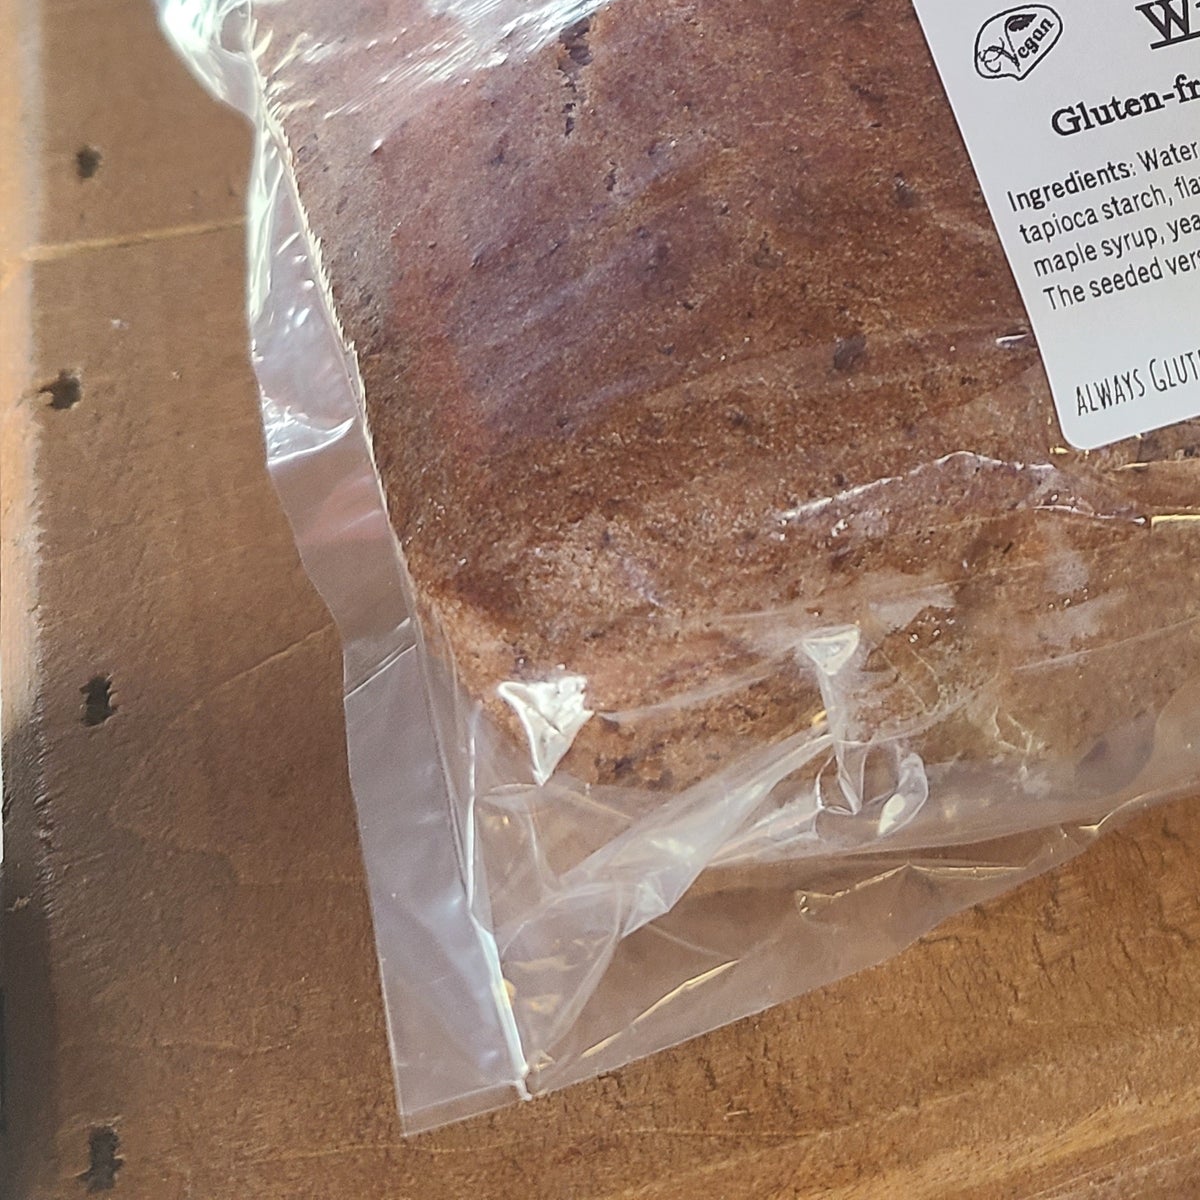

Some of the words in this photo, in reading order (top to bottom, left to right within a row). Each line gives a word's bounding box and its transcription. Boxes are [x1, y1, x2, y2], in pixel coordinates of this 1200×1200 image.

[977, 14, 1054, 72] Vegan
[1007, 161, 1137, 212] Ingredients:
[1019, 207, 1099, 244] tapioca
[1101, 184, 1173, 220] starch,
[1033, 242, 1098, 277] maple
[1100, 227, 1165, 259] syrup,
[1042, 284, 1086, 310] The
[1089, 256, 1164, 298] seeded
[1076, 368, 1145, 415] ALWAYS
